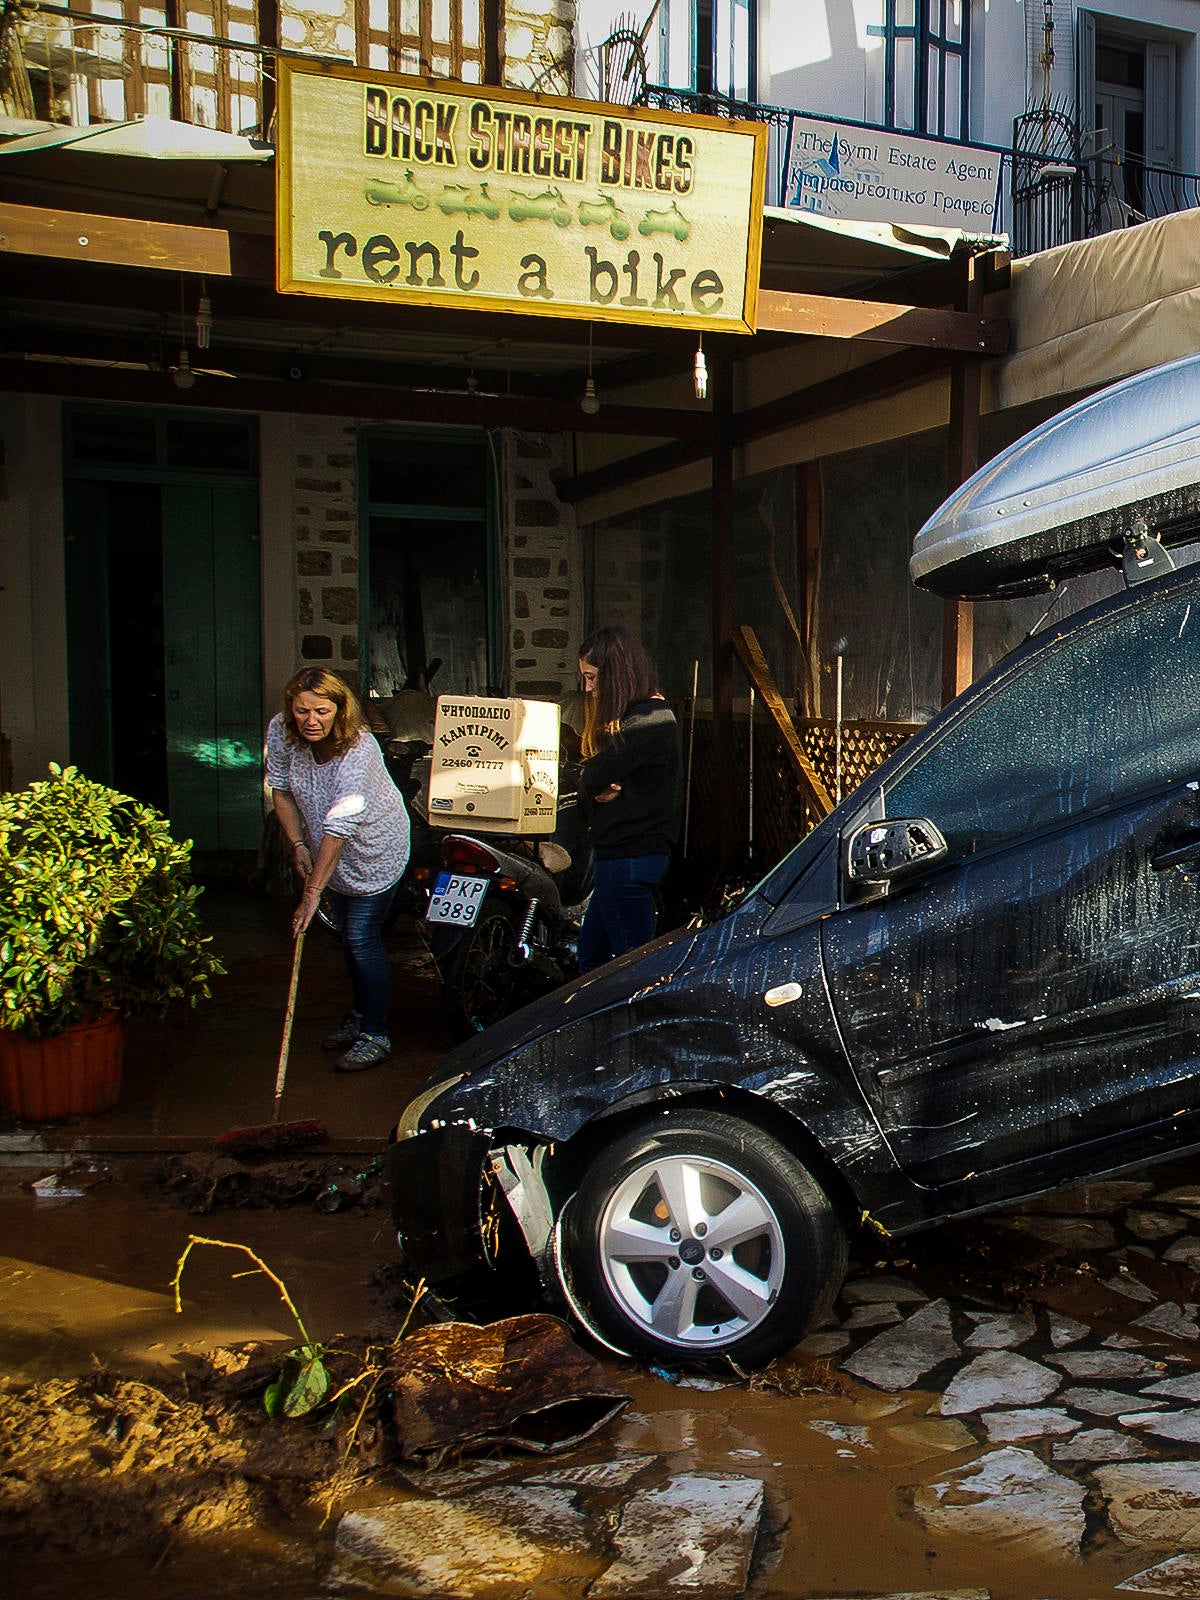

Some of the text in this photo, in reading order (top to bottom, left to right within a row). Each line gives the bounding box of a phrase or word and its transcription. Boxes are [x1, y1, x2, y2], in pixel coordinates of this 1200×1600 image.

[800, 131, 994, 182] The Symi Estate Agent
[932, 190, 994, 217] Γραφείο
[318, 229, 724, 315] rent a bike
[440, 704, 511, 720] ΨΗΤΟΠΩΛΕΙΟ
[439, 724, 510, 750] ΚΑΝΤΙΡΙΜΙ
[441, 758, 505, 770] 22460 71777
[446, 880, 483, 898] PKP
[438, 901, 476, 920] 389
